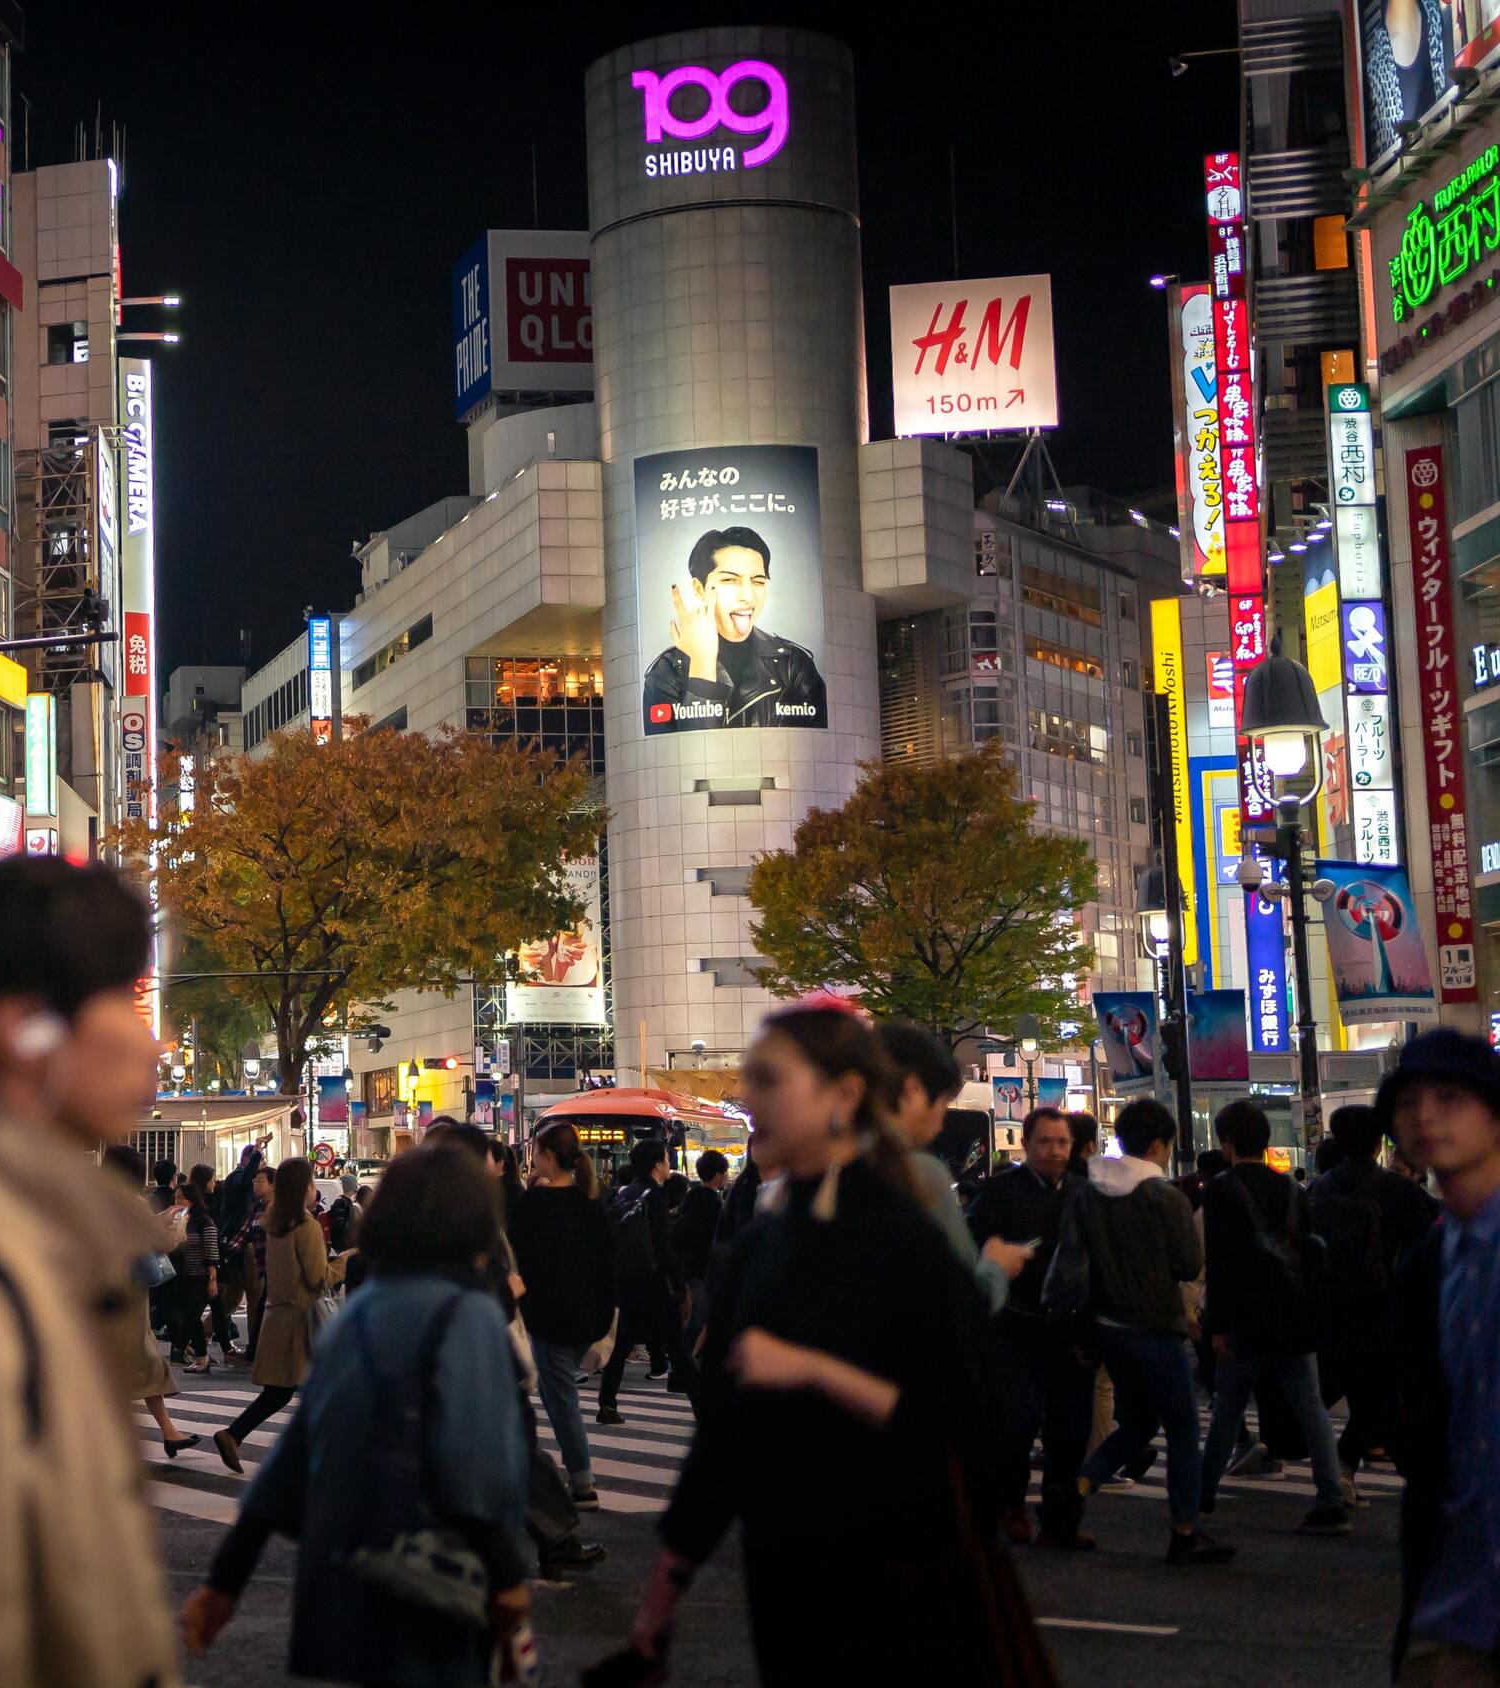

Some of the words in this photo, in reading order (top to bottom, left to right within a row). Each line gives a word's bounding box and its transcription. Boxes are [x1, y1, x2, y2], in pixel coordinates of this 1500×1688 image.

[631, 60, 790, 169] 109
[644, 147, 736, 178] SHIBUYA
[1219, 227, 1234, 237] 8F
[461, 264, 481, 331] THE
[1223, 301, 1238, 310] 8F
[456, 317, 489, 398] PRIME
[912, 294, 1032, 376] H&M
[125, 373, 147, 418] BIC
[122, 422, 149, 535] CAMERA
[659, 466, 740, 491] みんなの
[660, 493, 796, 520] 好きが、ここに。
[128, 634, 148, 675] 免税
[672, 700, 724, 720] YouTube
[775, 700, 817, 717] kemio
[124, 712, 145, 751] OS
[1370, 714, 1386, 761] フルーツ
[1376, 810, 1391, 860] 渋谷西村
[1451, 812, 1472, 919] 無料配送地域
[1258, 968, 1279, 1047] みずほ銀行
